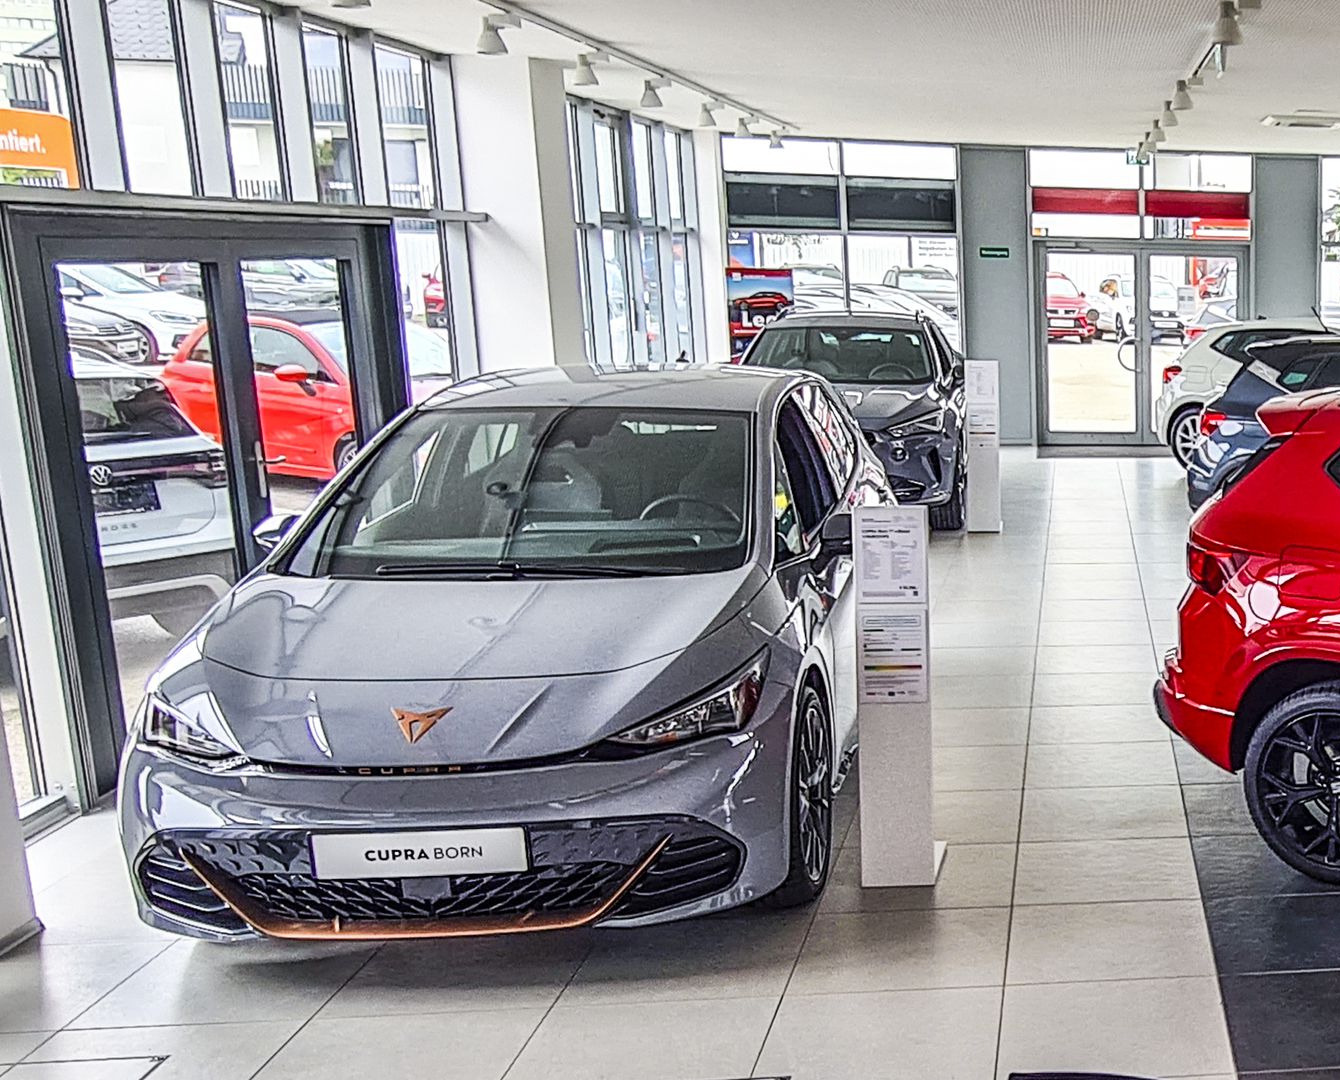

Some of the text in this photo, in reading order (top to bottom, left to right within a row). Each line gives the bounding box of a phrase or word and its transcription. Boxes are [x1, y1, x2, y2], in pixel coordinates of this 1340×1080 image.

[358, 766, 462, 775] CUPRA
[364, 846, 483, 862] CUPRA BORN
